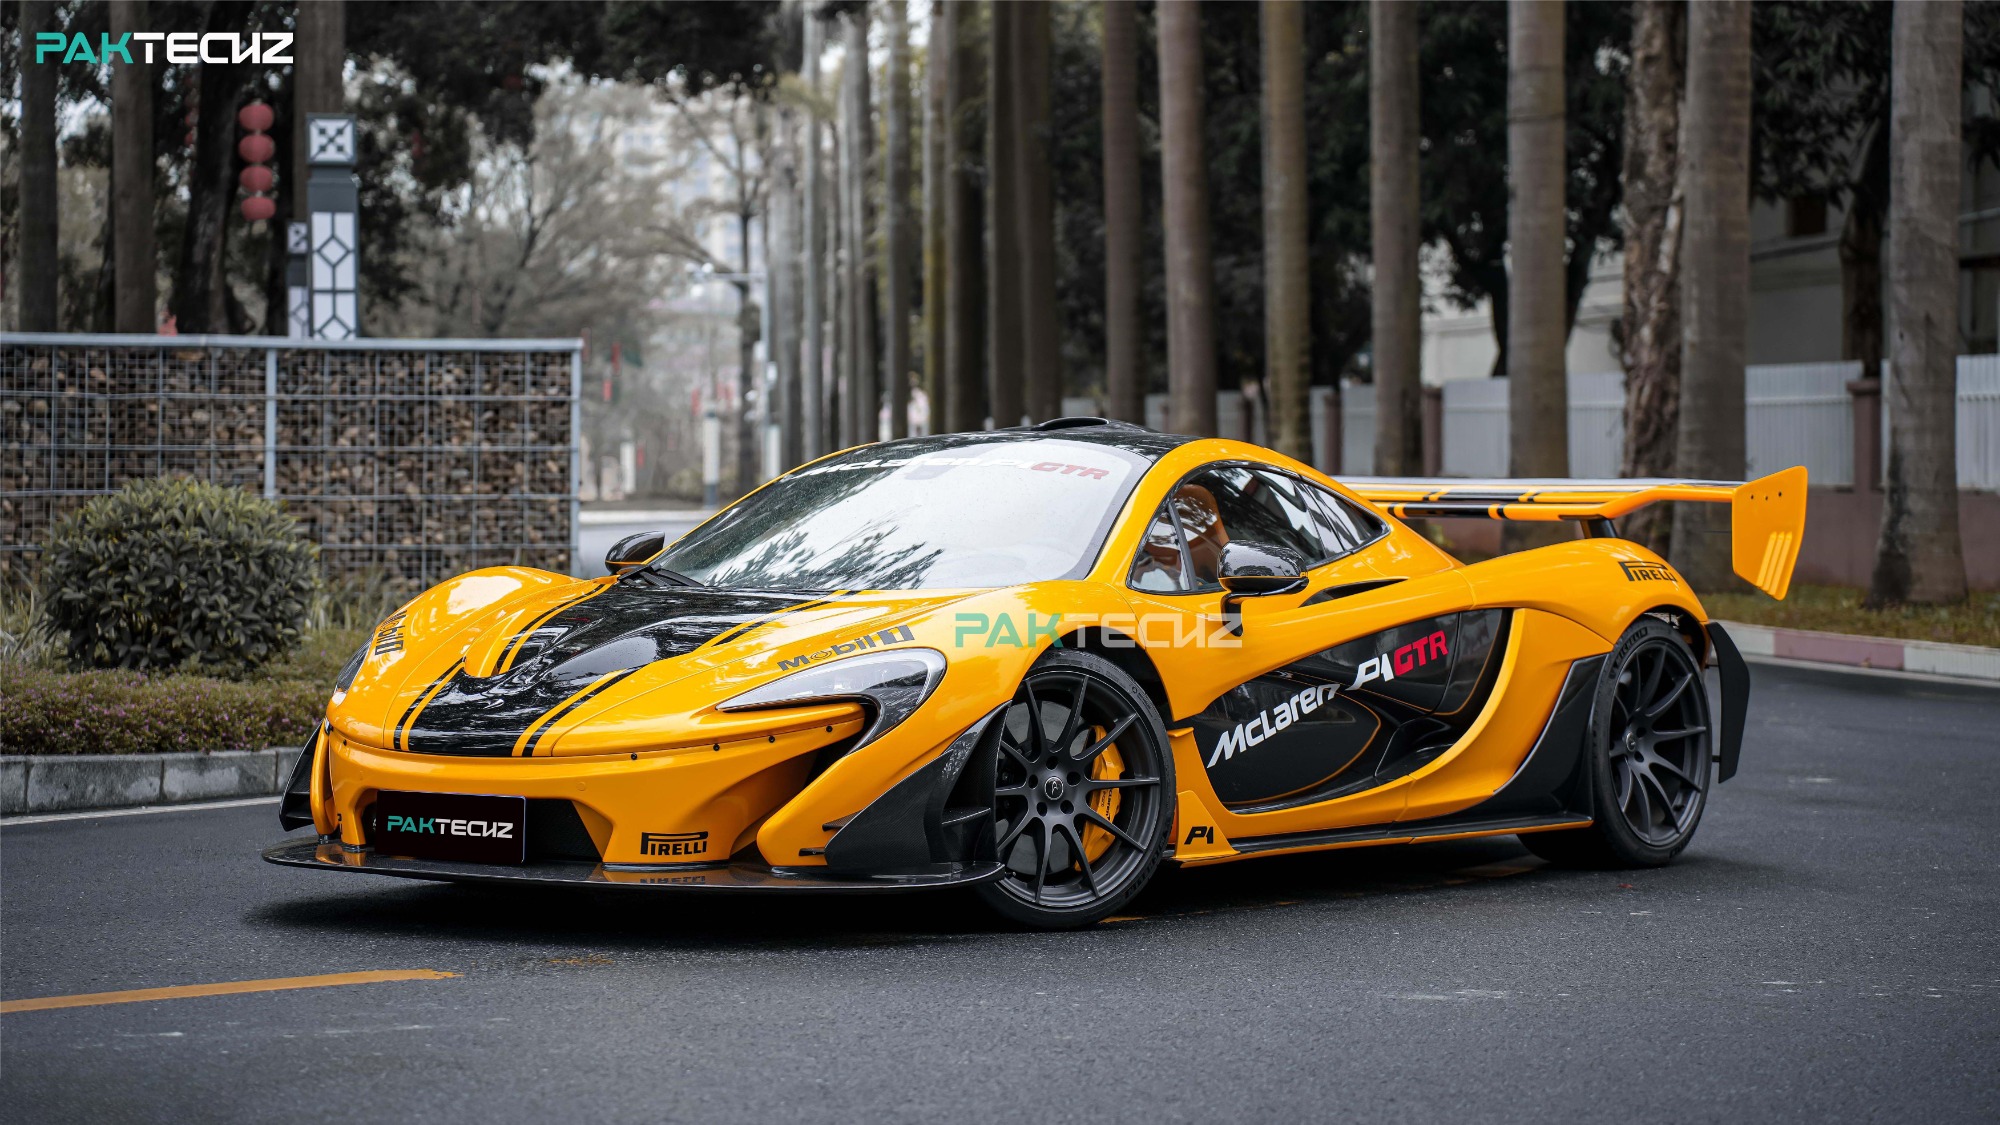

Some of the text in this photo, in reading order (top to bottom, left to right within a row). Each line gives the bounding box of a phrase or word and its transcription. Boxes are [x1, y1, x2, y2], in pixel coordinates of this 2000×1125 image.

[1617, 560, 1678, 582] PIRELLI
[1207, 683, 1341, 768] McLaren
[640, 831, 709, 856] PIRELLI
[1184, 826, 1214, 845] P1
